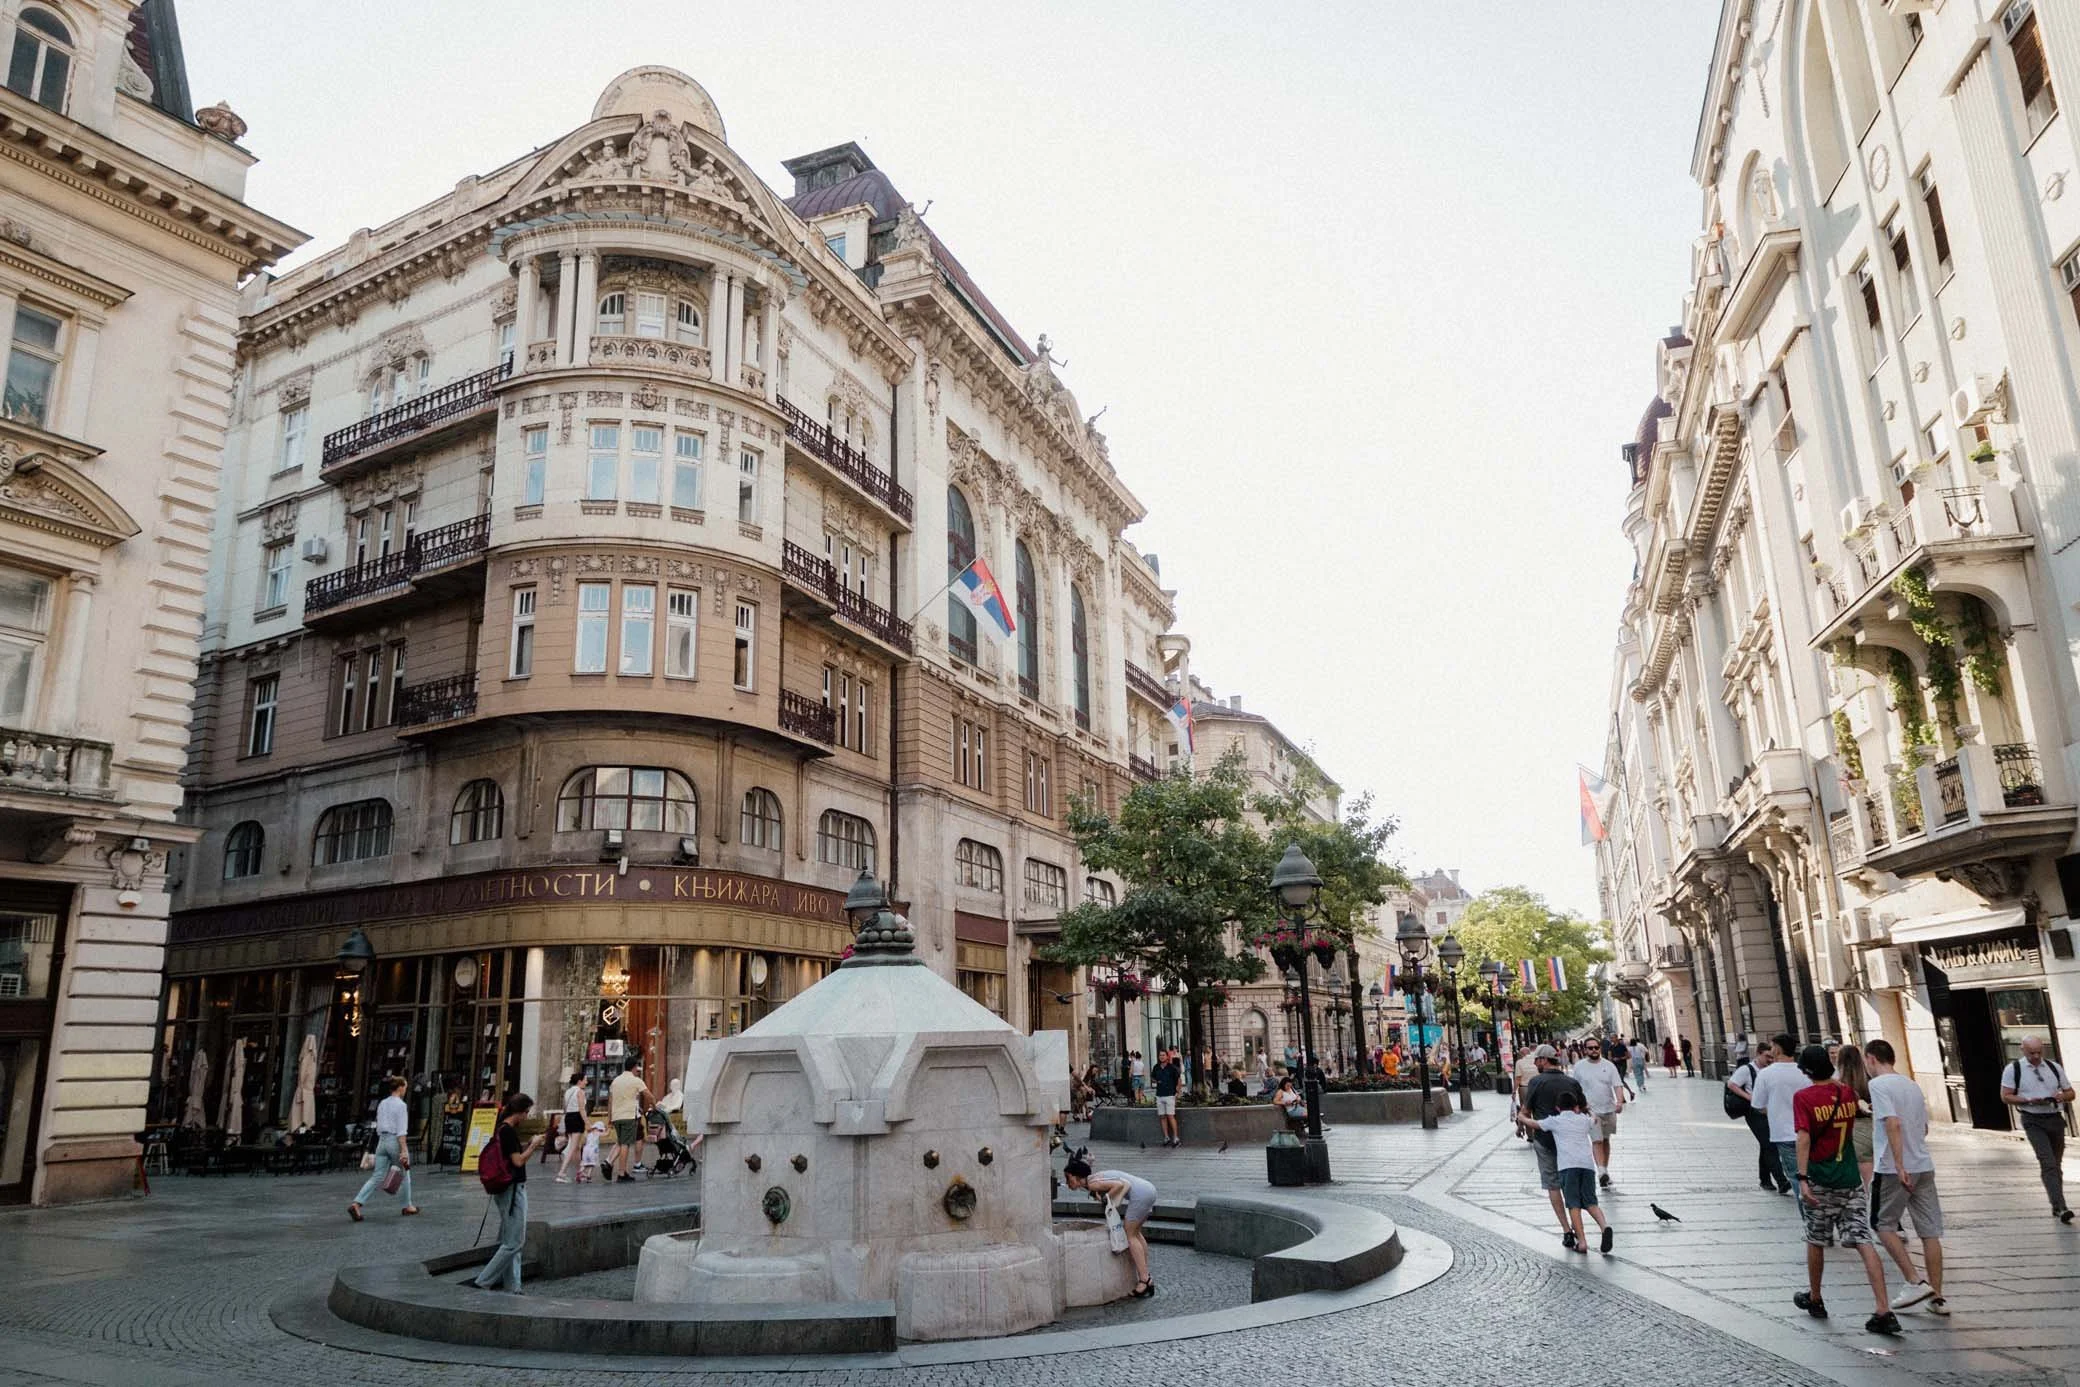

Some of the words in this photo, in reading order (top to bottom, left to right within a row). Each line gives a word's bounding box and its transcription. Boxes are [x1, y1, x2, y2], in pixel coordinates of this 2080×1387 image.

[455, 872, 616, 906] УМЕТНОСТИ
[675, 875, 781, 908] КЊИЖАРА
[1833, 1121, 1848, 1162] 7
